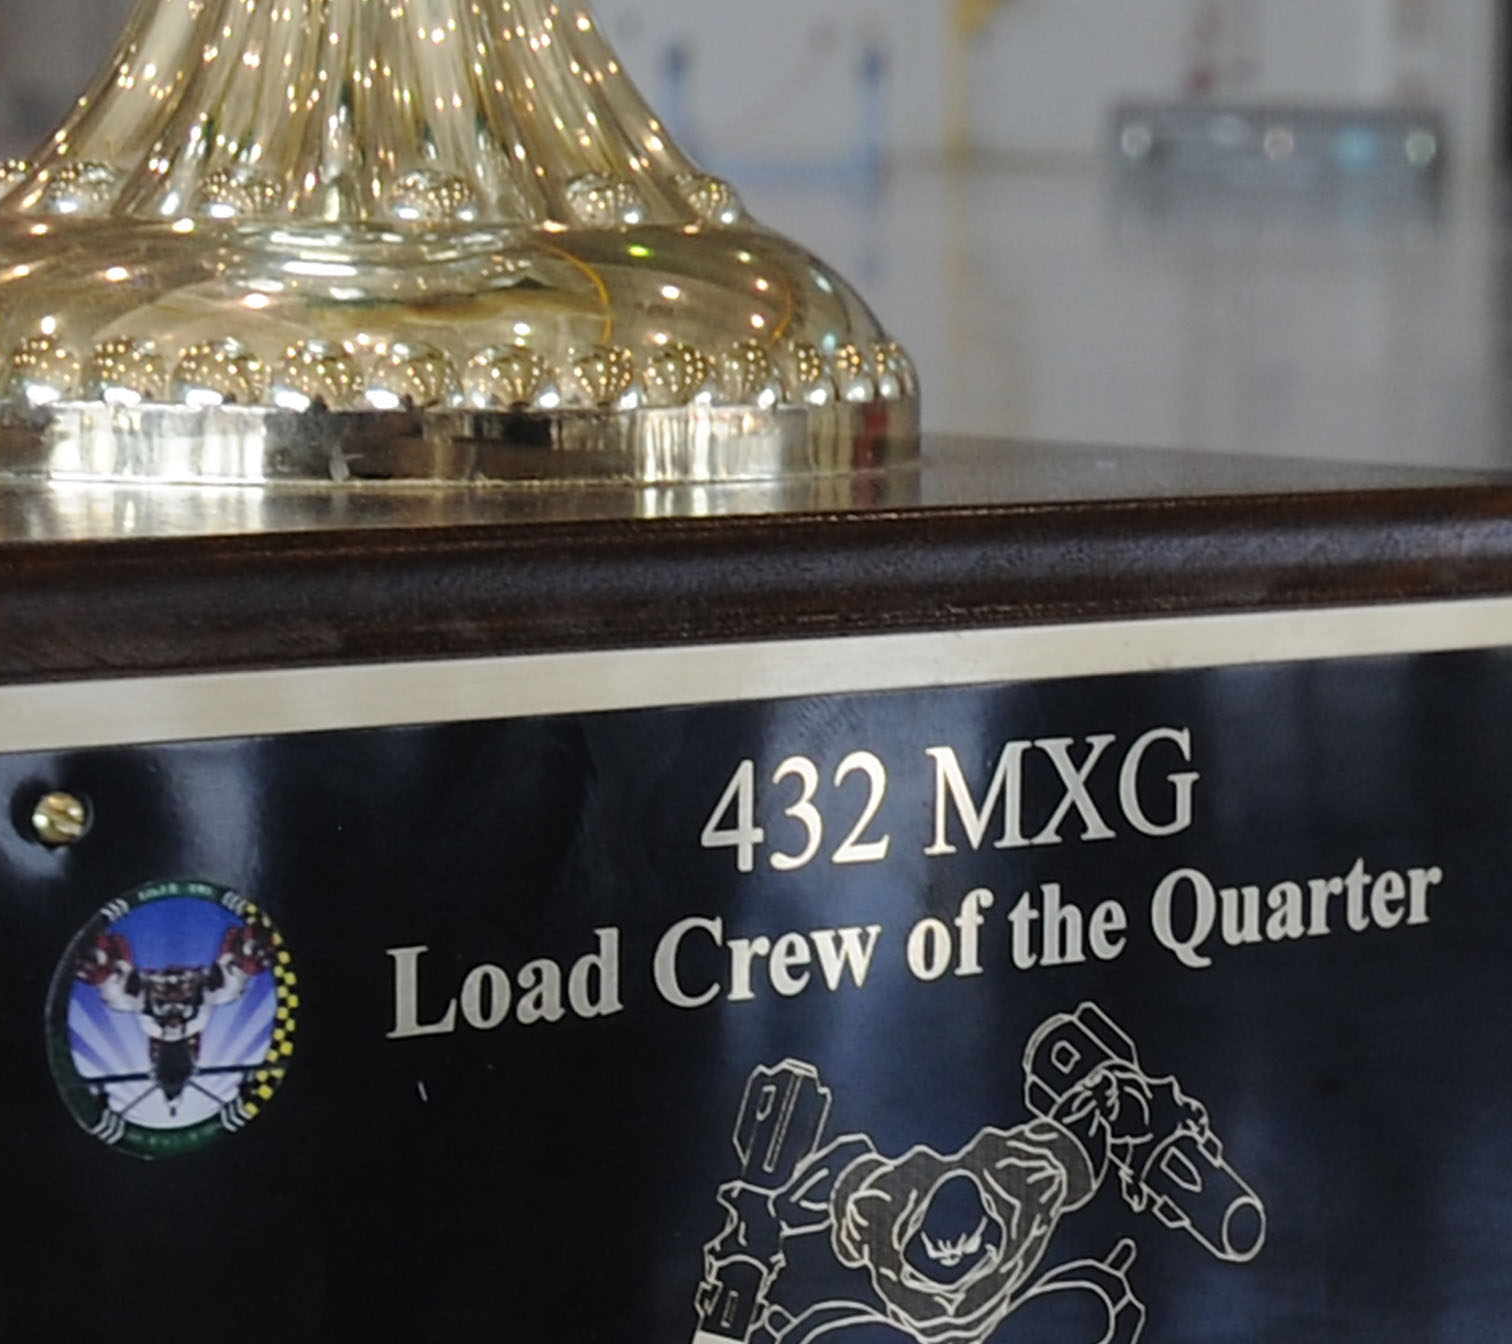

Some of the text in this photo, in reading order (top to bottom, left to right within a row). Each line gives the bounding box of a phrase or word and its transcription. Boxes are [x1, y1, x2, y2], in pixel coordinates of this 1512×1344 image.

[700, 726, 1201, 873] 432 MXG
[385, 857, 1443, 1039] Load Crew of the Quarter
